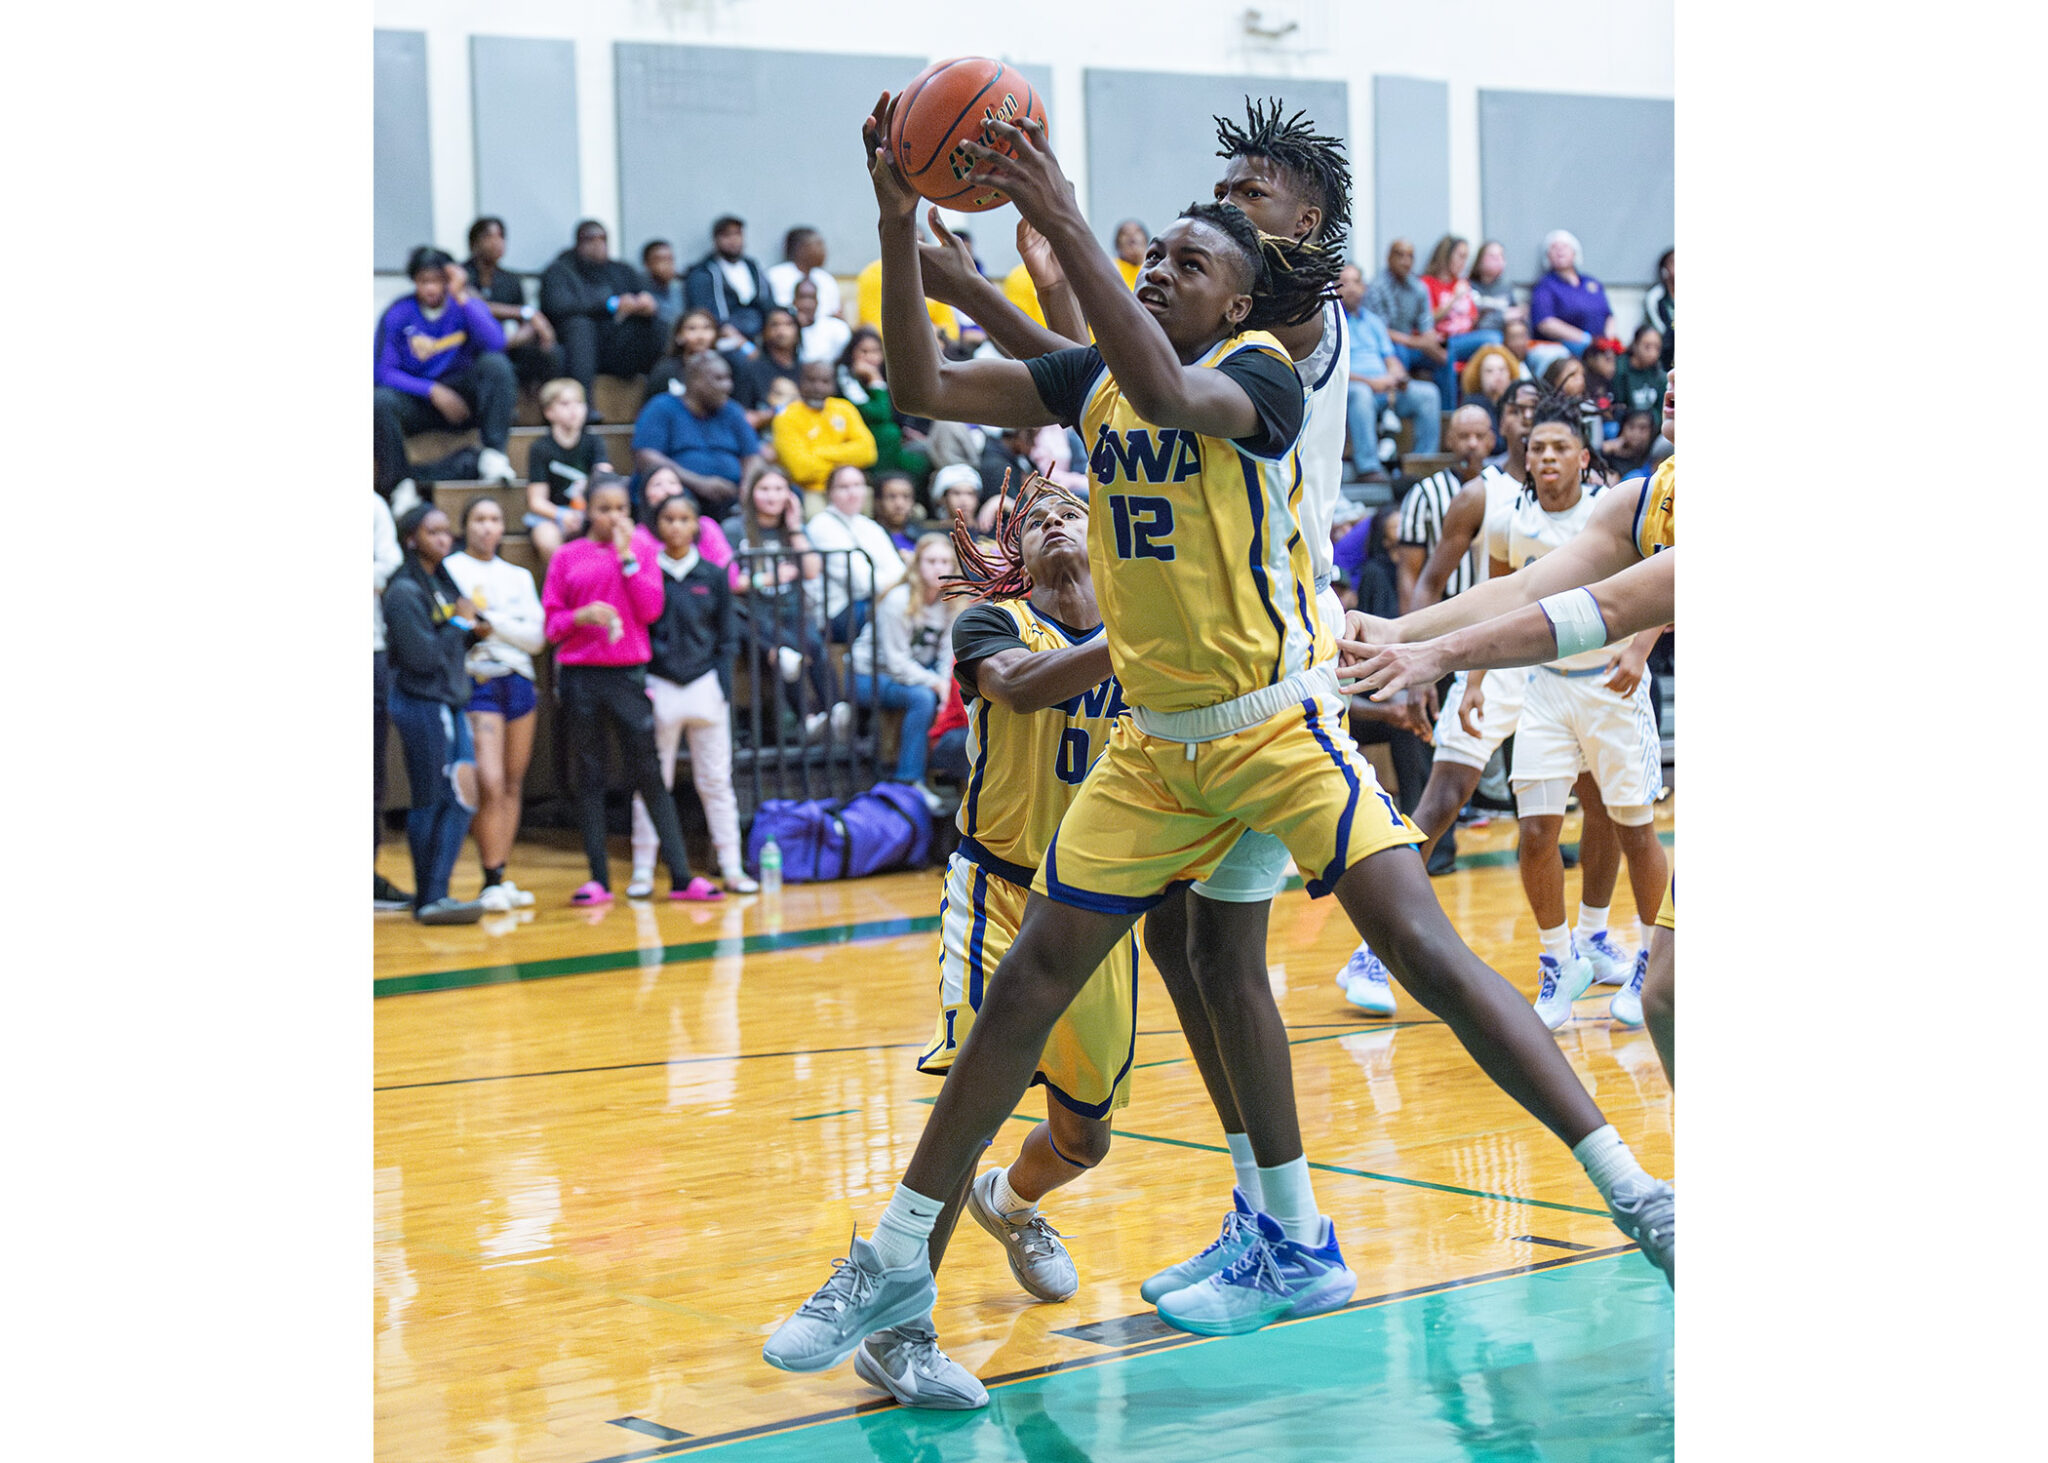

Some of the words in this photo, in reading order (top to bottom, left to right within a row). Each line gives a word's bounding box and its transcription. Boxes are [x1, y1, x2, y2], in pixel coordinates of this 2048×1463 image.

[1108, 494, 1177, 562] 12
[1054, 727, 1090, 786] 0
[945, 1008, 958, 1051] I
